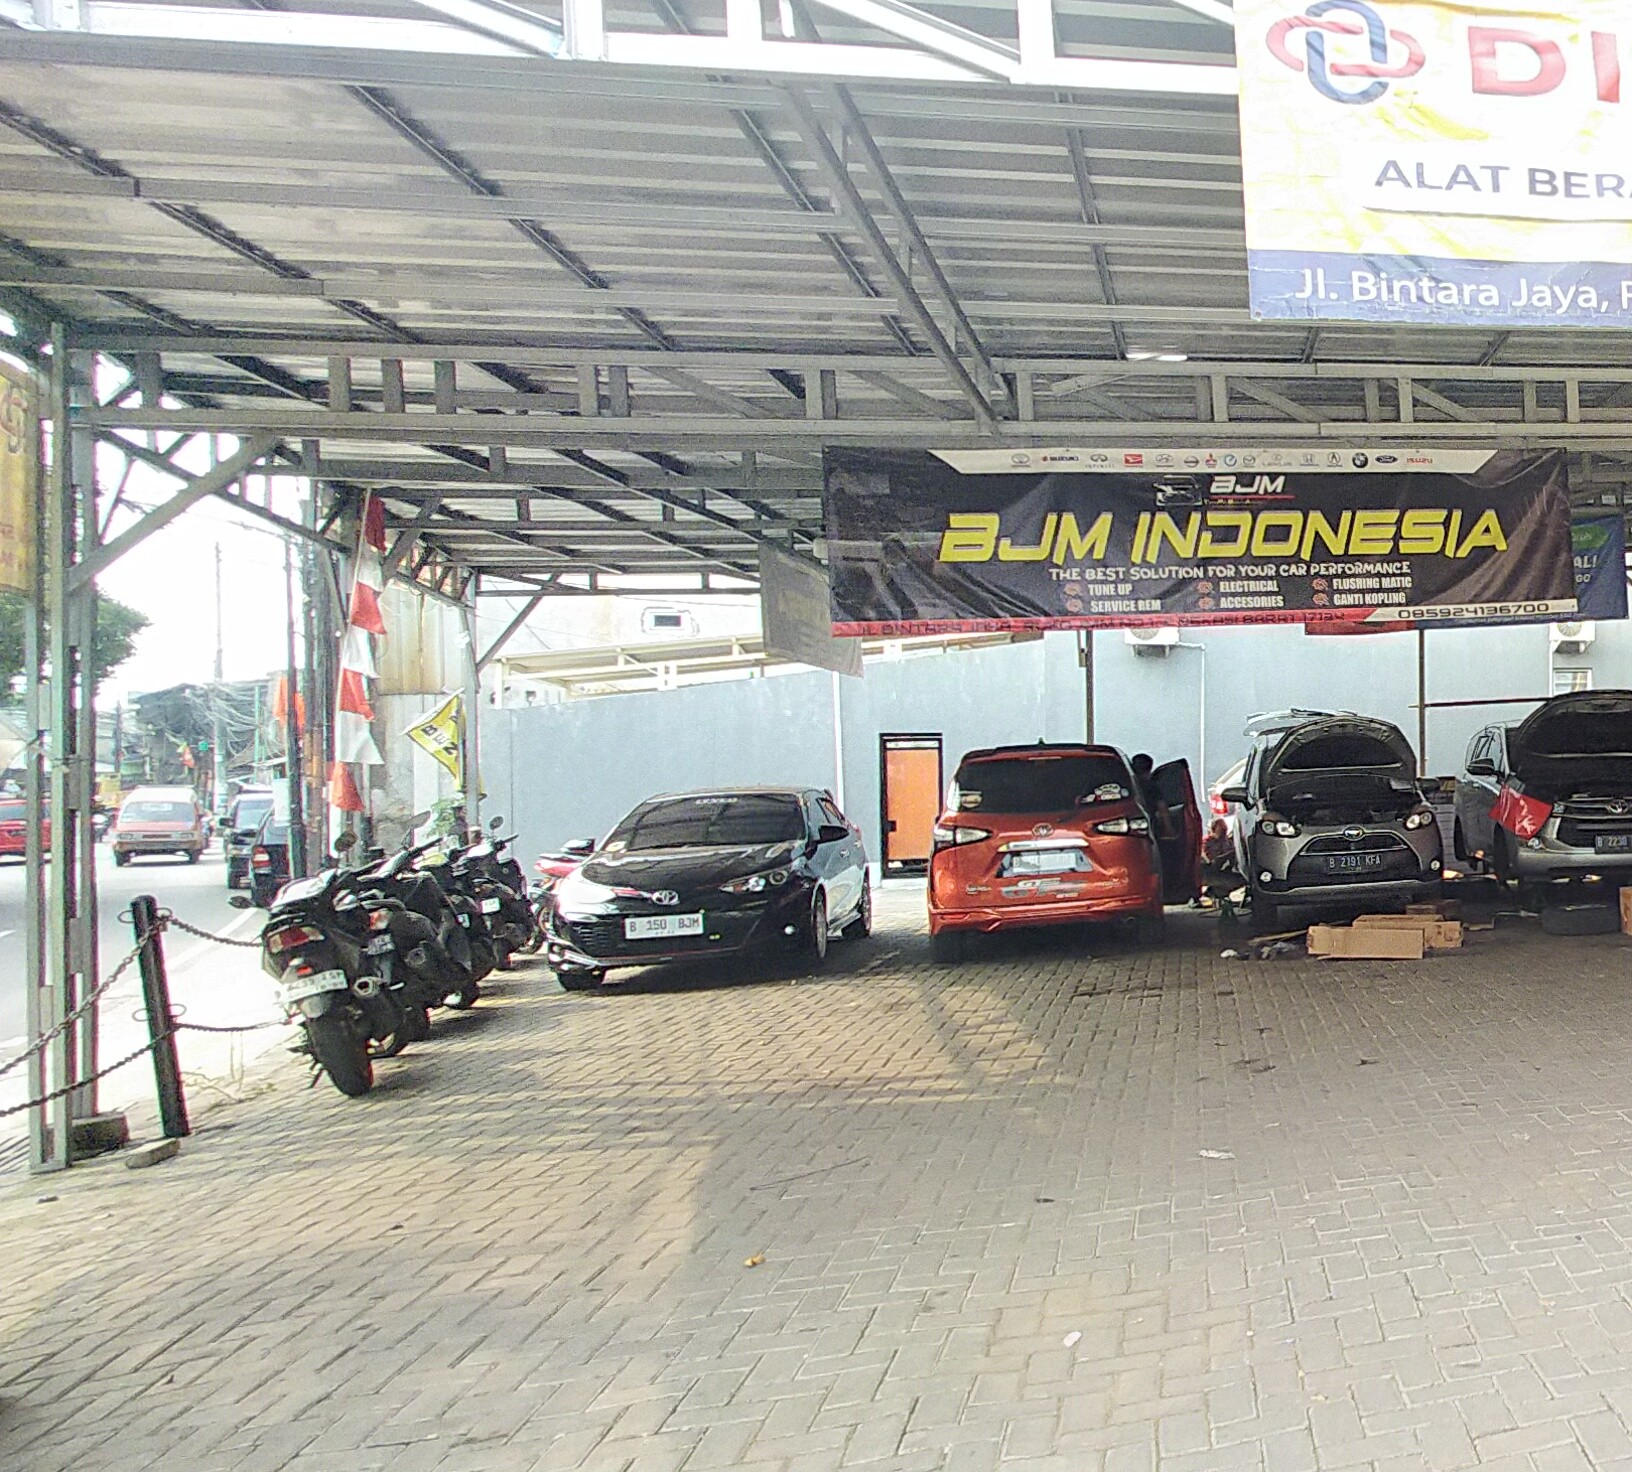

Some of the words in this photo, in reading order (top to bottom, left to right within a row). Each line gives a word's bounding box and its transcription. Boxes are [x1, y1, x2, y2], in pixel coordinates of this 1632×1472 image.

[1375, 159, 1509, 193] ALAT
[1295, 268, 1339, 300] Jl.
[1351, 271, 1499, 306] Bintara
[1511, 278, 1609, 314] Jaya,
[1210, 475, 1286, 495] BJM
[938, 511, 1113, 566] BJM
[1130, 508, 1508, 566] INDONESIA
[1049, 568, 1081, 581] THE
[1085, 567, 1126, 581] BEST
[1129, 566, 1204, 580] SOLUTION
[1208, 564, 1236, 578] FOR
[1238, 563, 1276, 577] YOUR
[1279, 563, 1307, 576] CAR
[1310, 561, 1411, 576] PERFORMANCE
[1088, 584, 1115, 596] TUNE
[1117, 583, 1132, 595] UP
[1219, 579, 1279, 593] ELECTRICAL
[1333, 578, 1380, 590] FLUSHING
[1381, 576, 1412, 589] MATIC
[1090, 600, 1136, 613] SERVICE
[1138, 599, 1162, 612] REM
[1219, 596, 1284, 609] ACCESORIES
[1333, 593, 1362, 606] GANTI
[1364, 592, 1406, 605] KOPLING
[1398, 603, 1549, 619] 085924136700
[1329, 857, 1336, 869] B
[1340, 856, 1361, 868] 2191
[1365, 854, 1381, 866] KFA
[629, 920, 637, 933] B
[646, 918, 668, 931] 150
[678, 916, 701, 929] BJM
